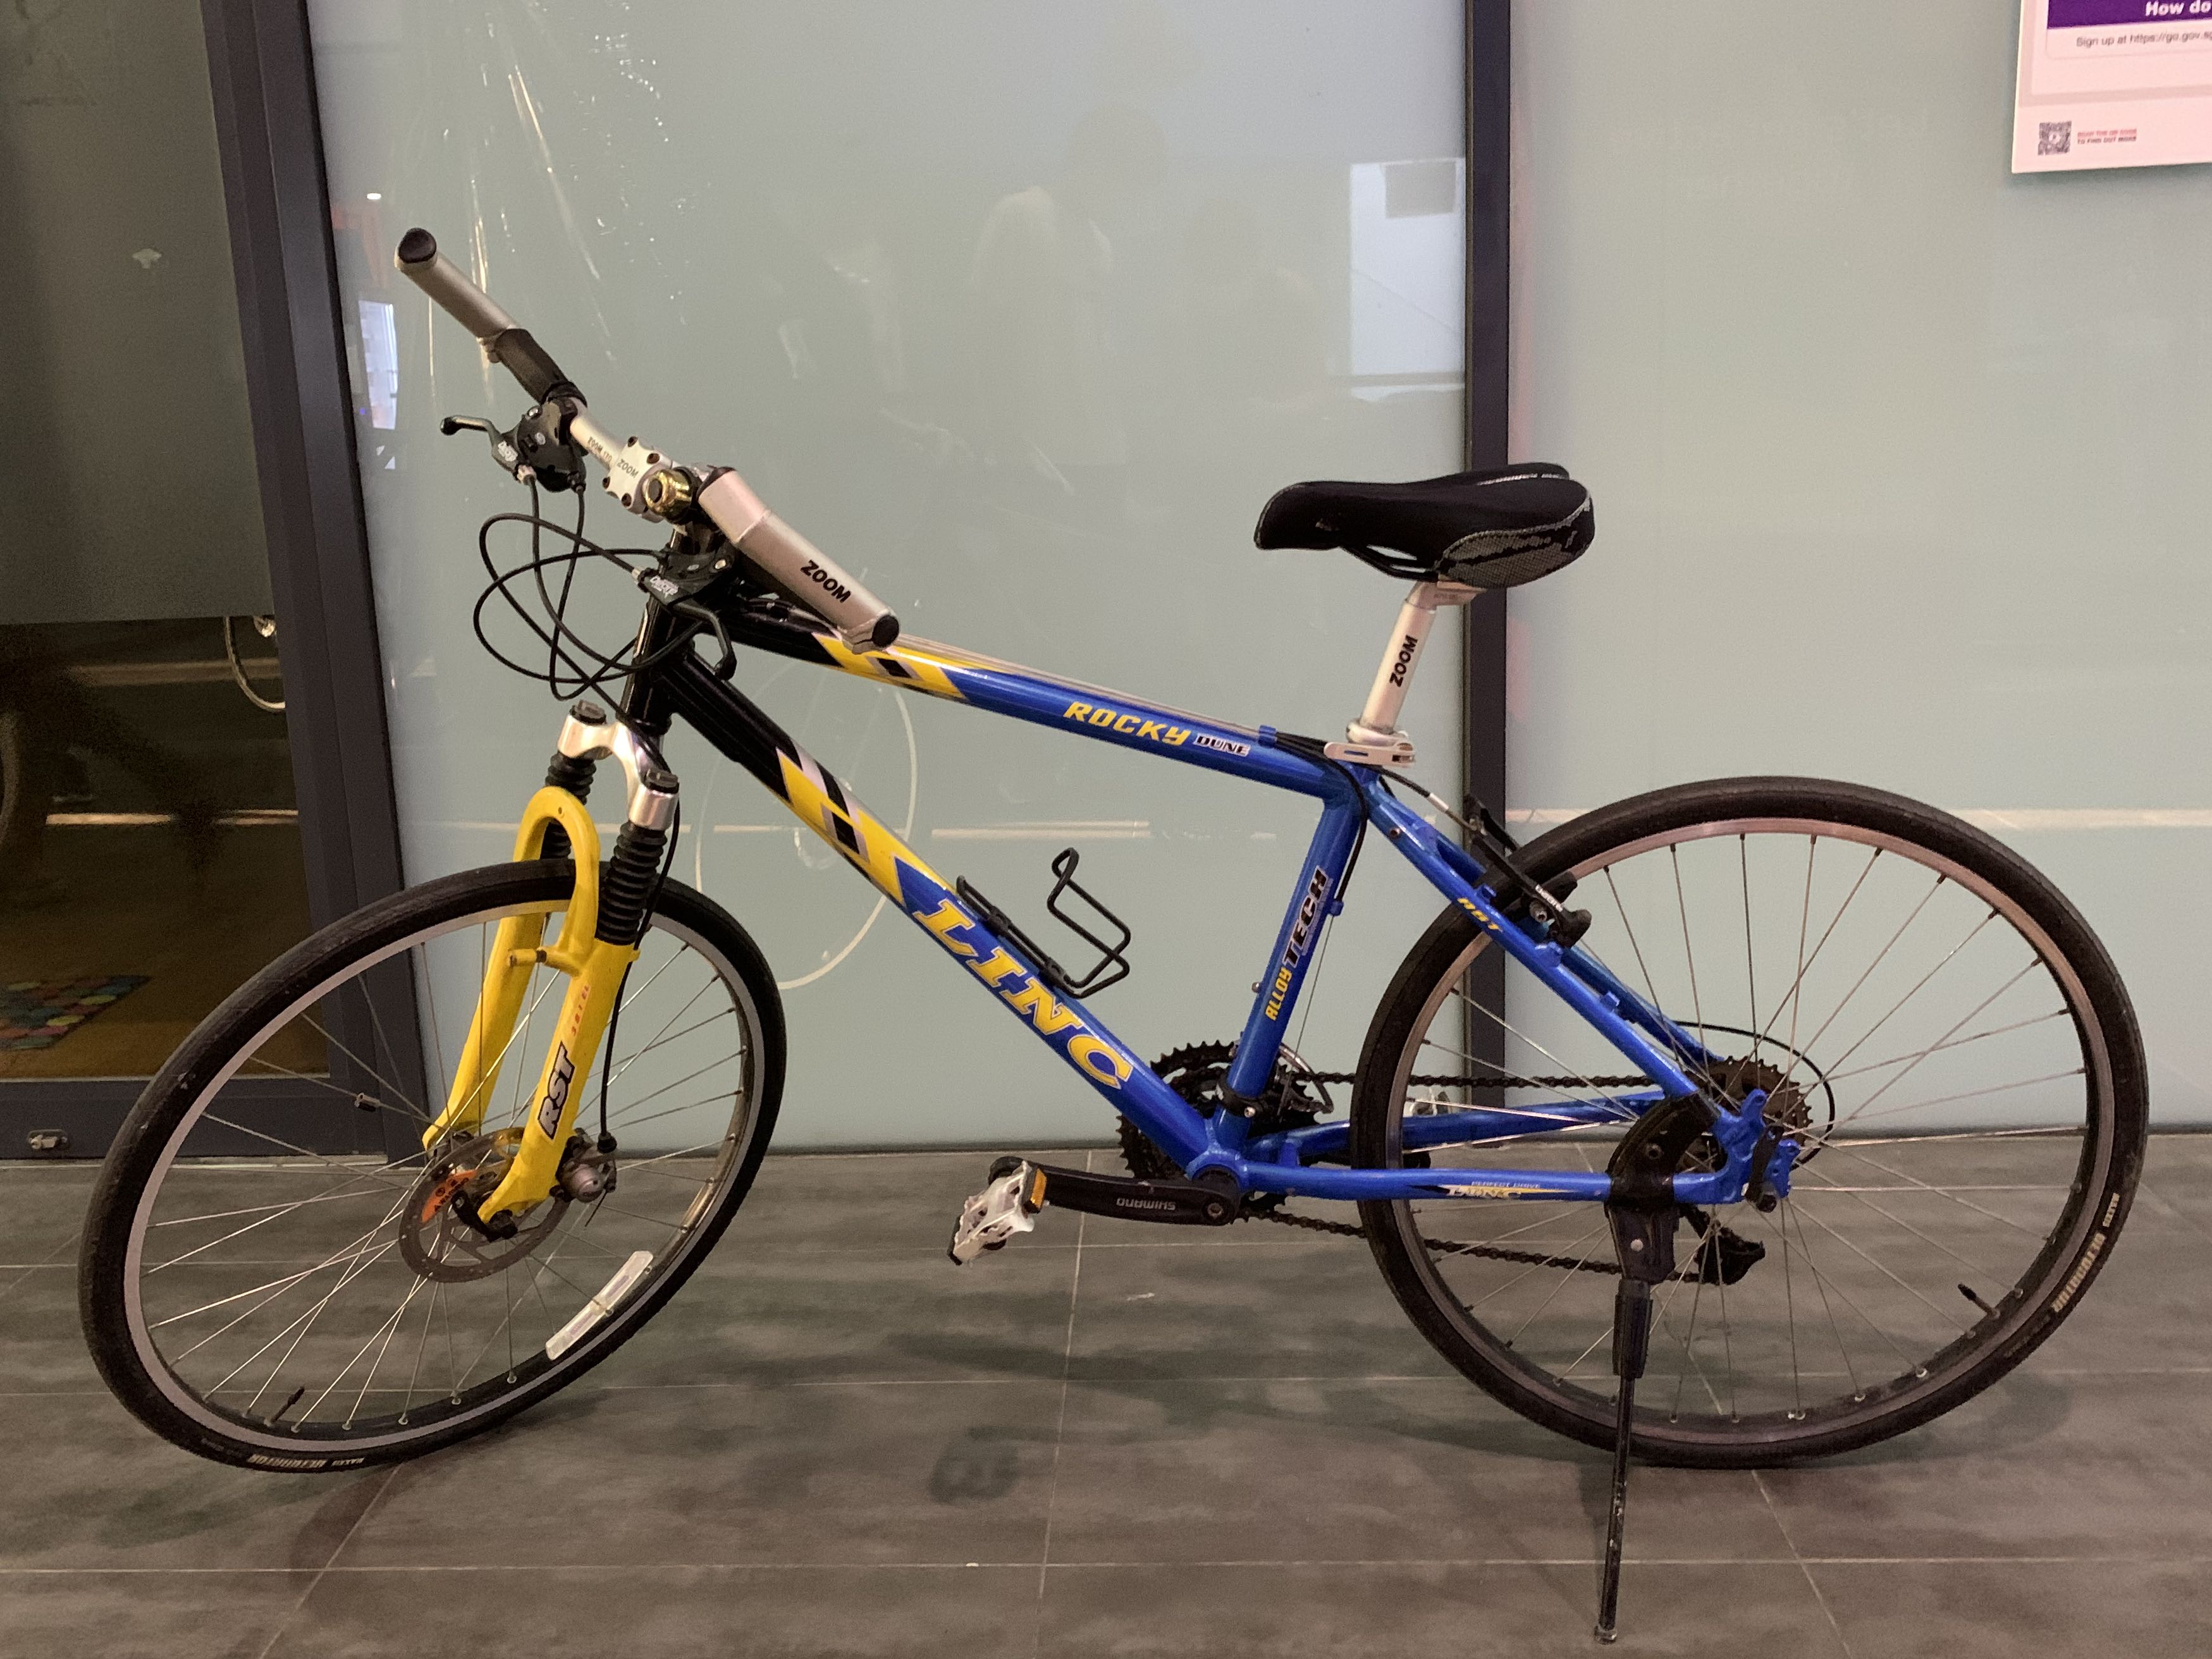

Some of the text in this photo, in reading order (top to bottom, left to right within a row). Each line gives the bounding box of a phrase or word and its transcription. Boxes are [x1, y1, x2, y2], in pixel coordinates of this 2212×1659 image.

[2146, 0, 2211, 16] How do
[2076, 37, 2099, 48] Sign
[2101, 37, 2115, 46] up
[2117, 35, 2127, 44] at
[617, 458, 639, 479] ZOOM
[800, 560, 851, 603] ZOOM
[1389, 634, 1418, 687] ZOOM
[1063, 701, 1251, 757] ROCKY DUNE
[1265, 865, 1330, 1020] ALLOY TECH
[912, 898, 1133, 1089] LINC
[538, 1040, 575, 1140] RST
[1115, 1197, 1176, 1210] SHIMANO
